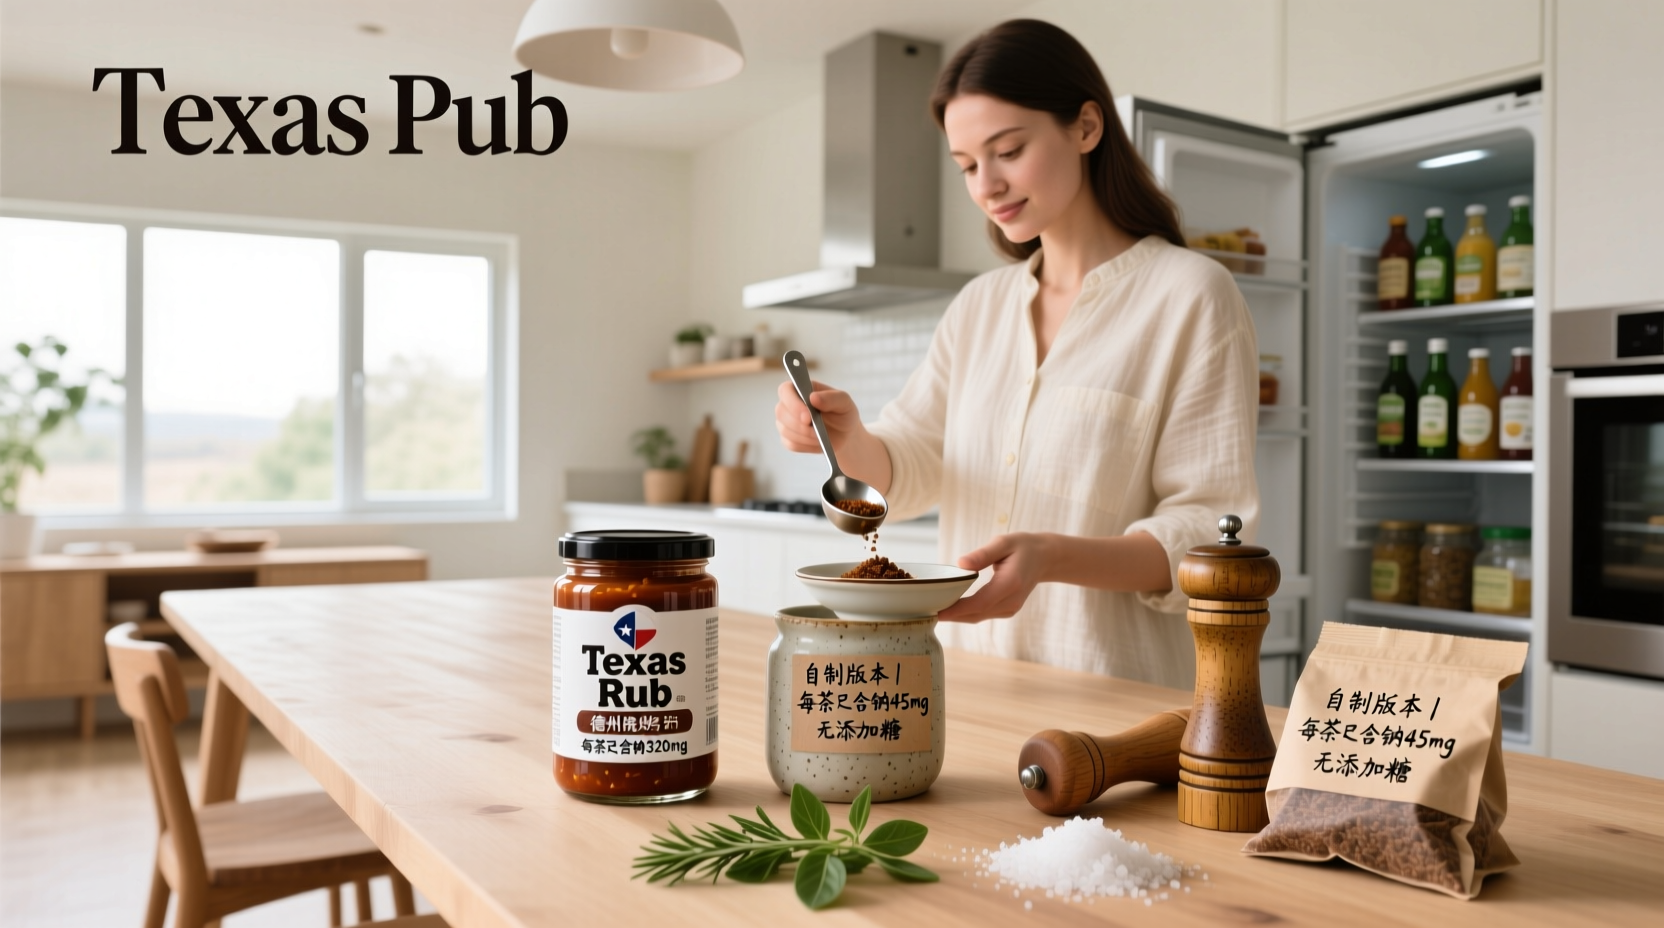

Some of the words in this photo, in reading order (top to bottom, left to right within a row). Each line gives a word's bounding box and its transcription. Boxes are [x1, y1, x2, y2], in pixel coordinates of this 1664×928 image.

[581, 644, 686, 676] Texas
[598, 678, 672, 708] Rub
[817, 717, 903, 742] 无添加糖
[1313, 751, 1412, 784] 无添加糖
